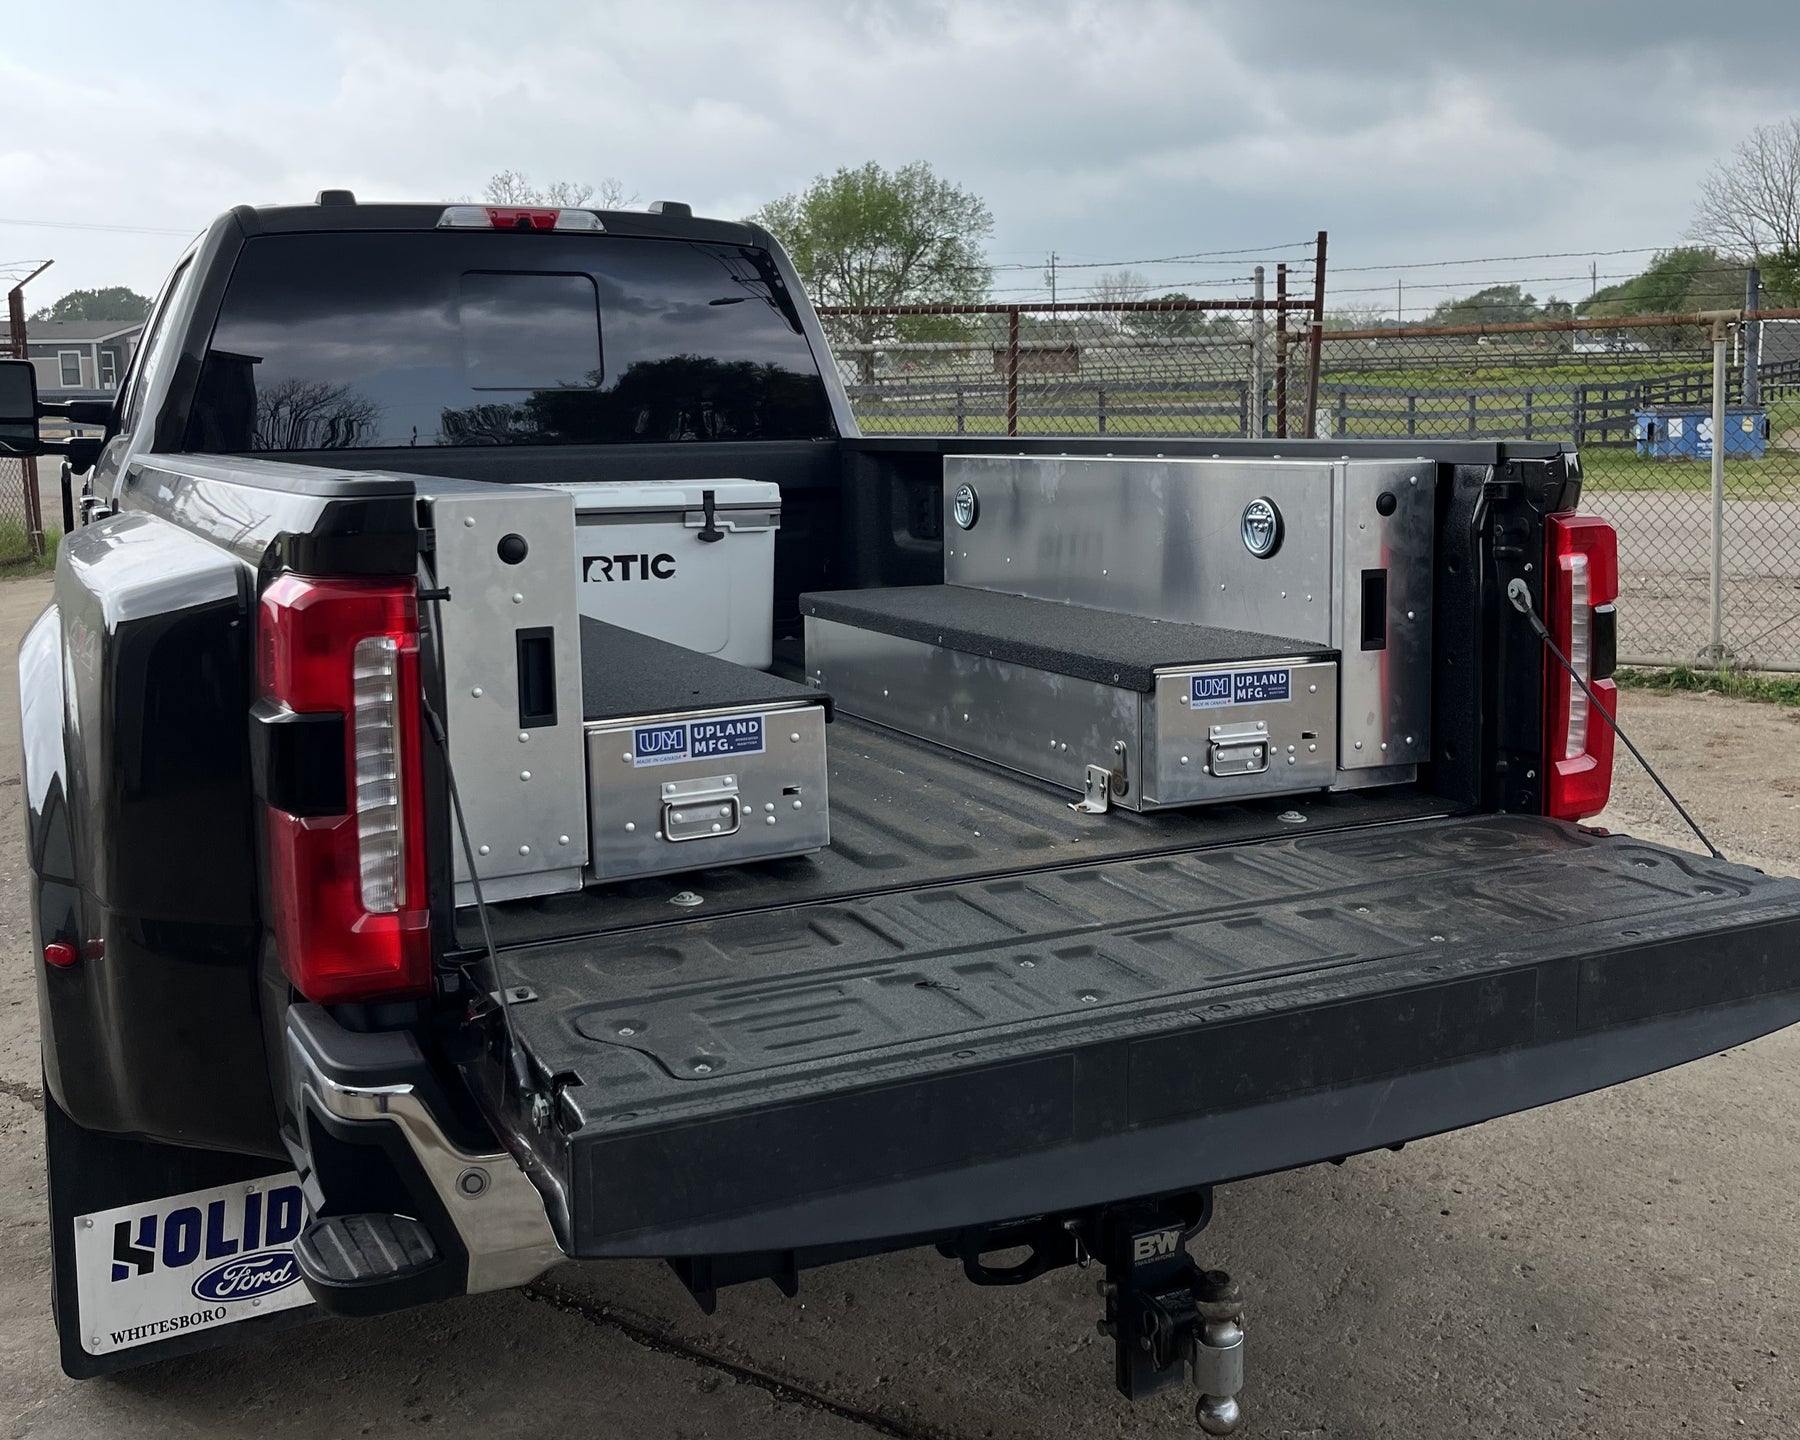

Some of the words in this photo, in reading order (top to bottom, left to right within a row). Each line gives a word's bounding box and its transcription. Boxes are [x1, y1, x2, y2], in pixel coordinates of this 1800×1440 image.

[583, 553, 676, 583] RTIC
[1236, 673, 1287, 687] UPLAND
[1236, 687, 1267, 700] MFG.
[693, 721, 759, 739] UPLAND
[694, 738, 734, 754] MFG.
[659, 754, 682, 762] CANADA
[111, 1185, 312, 1283] HOLID
[215, 1257, 293, 1296] Ford
[110, 1306, 227, 1345] WHITESBORO
